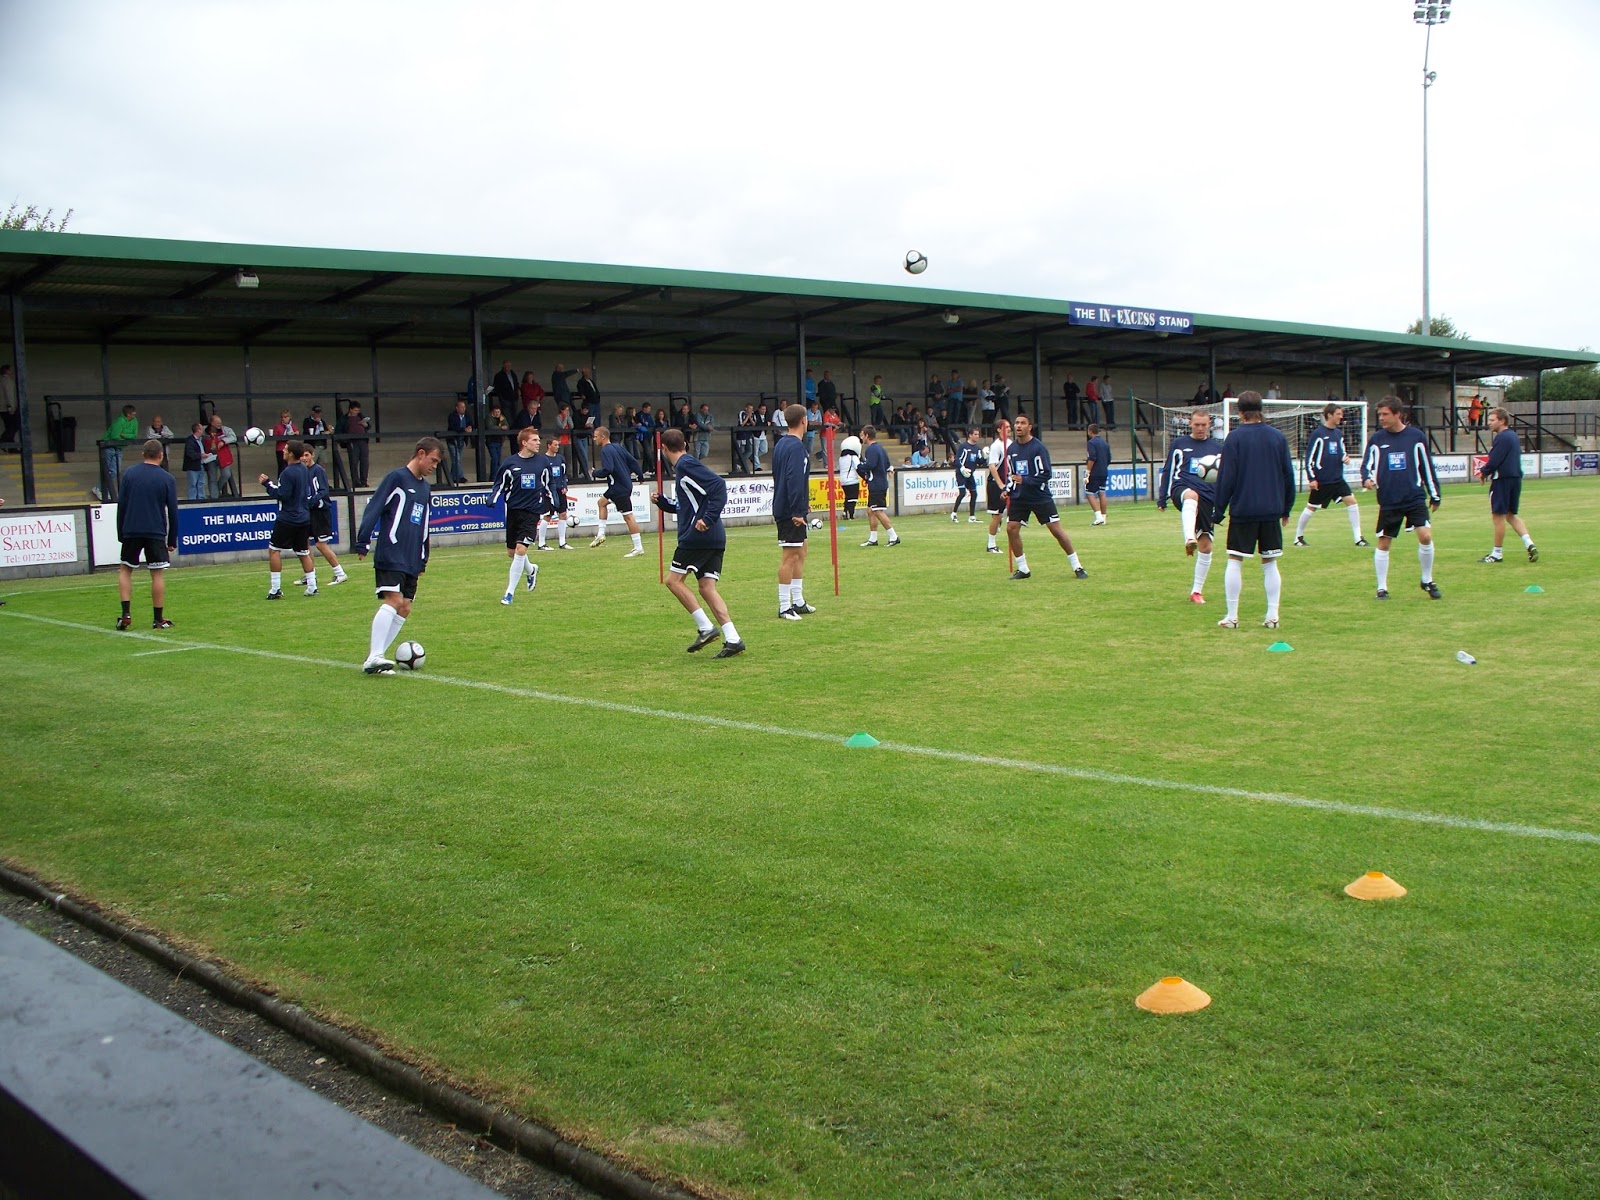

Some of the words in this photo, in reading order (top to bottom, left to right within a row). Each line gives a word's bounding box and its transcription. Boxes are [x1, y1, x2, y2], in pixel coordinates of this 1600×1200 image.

[1075, 308, 1095, 320] THE
[1159, 315, 1190, 328] STAND
[905, 476, 948, 490] Salisbury
[1049, 480, 1070, 489] ERVICES
[1110, 473, 1147, 491] SQUARE
[431, 496, 460, 507] Glass
[462, 494, 488, 505] Cent
[727, 497, 743, 505] ACH
[744, 496, 762, 504] HIRE
[915, 492, 938, 501] EVERY
[941, 491, 959, 499] THUR
[95, 509, 101, 520] B
[203, 514, 224, 525] THE
[226, 511, 277, 524] MARLAND
[461, 523, 479, 531] 01722
[182, 532, 232, 546] SUPPORT
[234, 529, 274, 542] SALISB
[5, 555, 20, 563] Tel:
[22, 553, 46, 563] 01722
